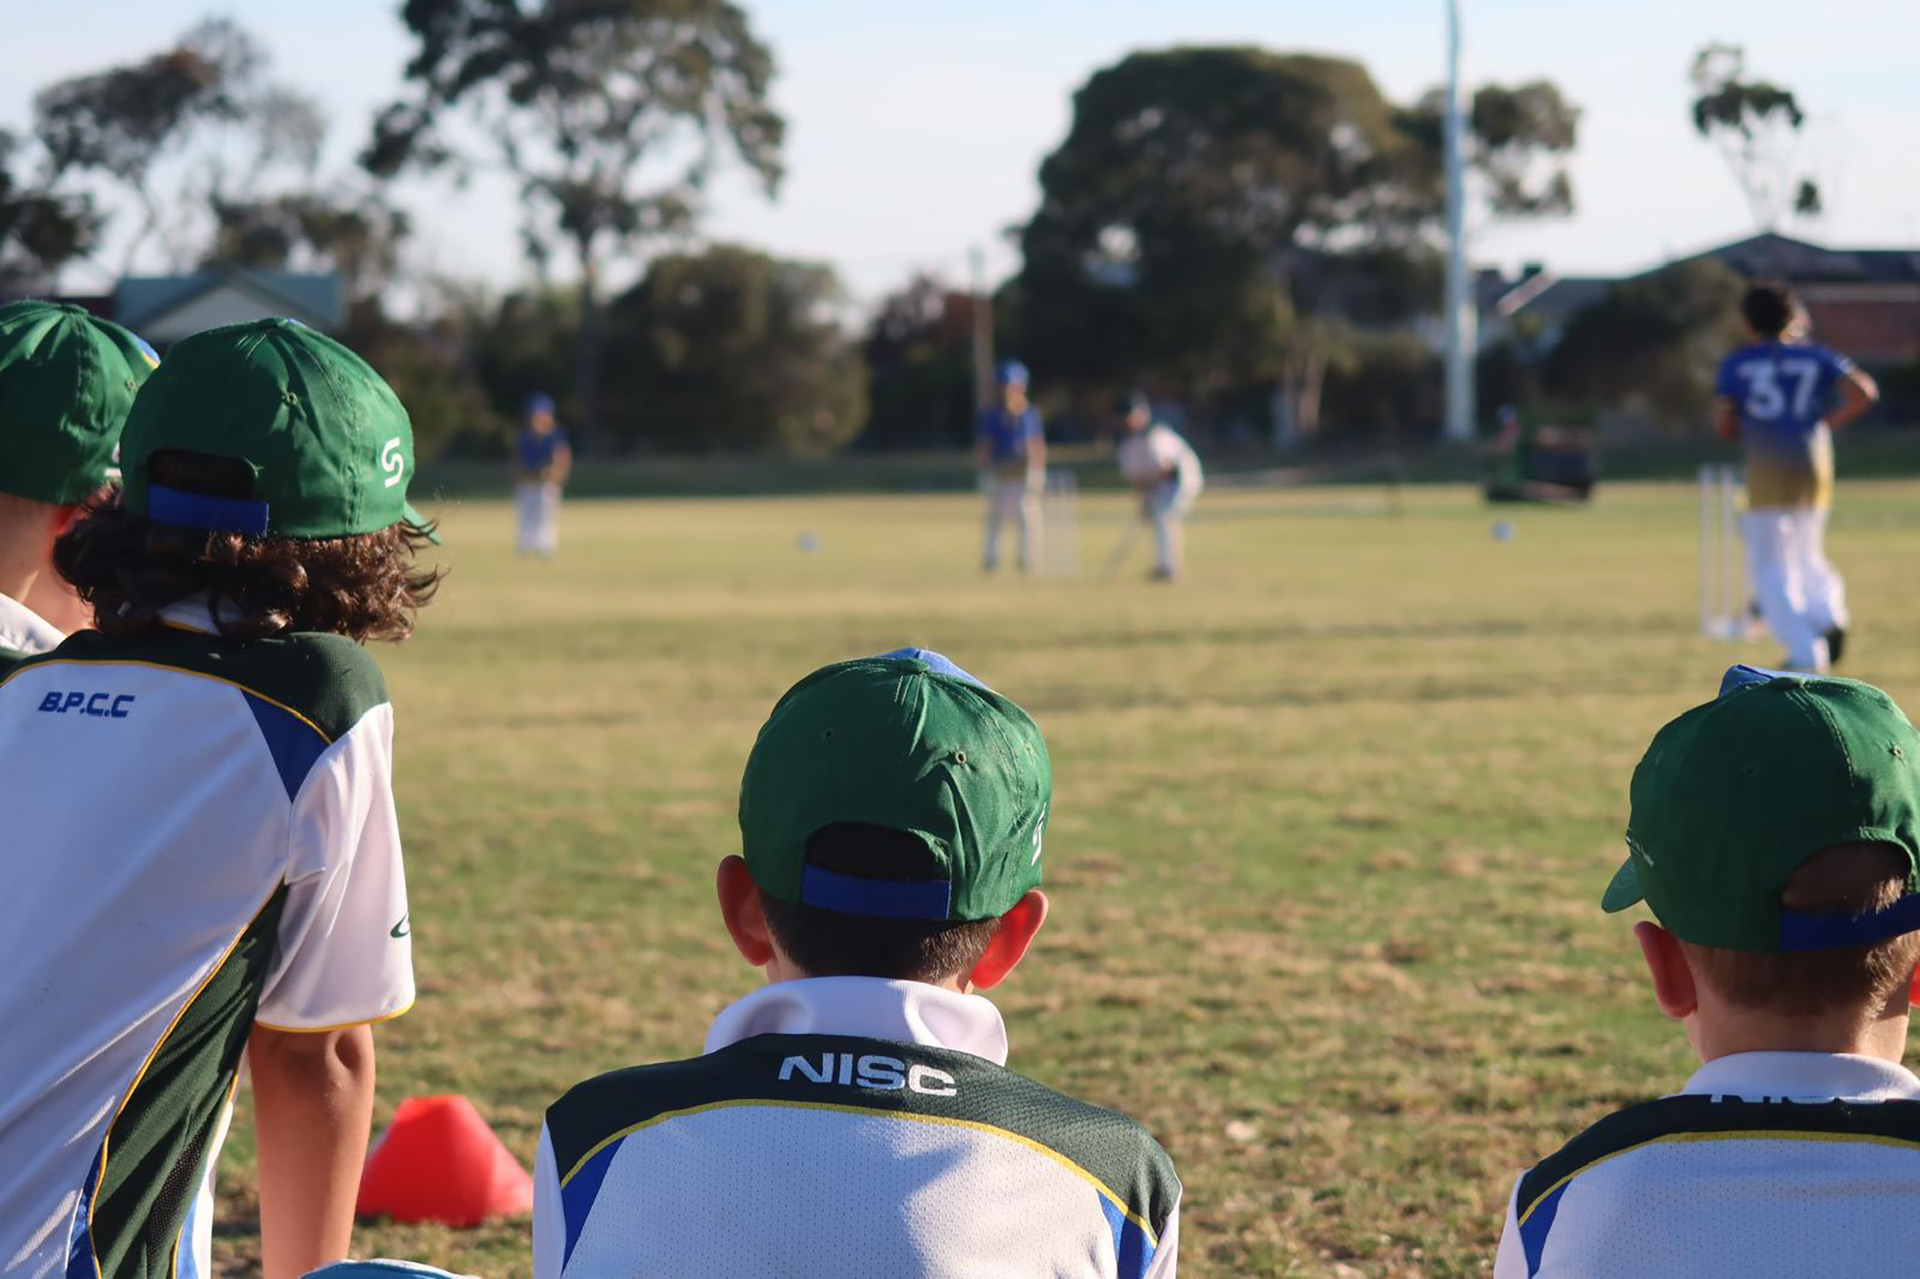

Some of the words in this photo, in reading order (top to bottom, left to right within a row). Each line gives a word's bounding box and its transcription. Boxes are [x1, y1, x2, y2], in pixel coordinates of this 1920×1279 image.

[1737, 357, 1821, 420] 37
[38, 691, 136, 718] B.P.C.C
[778, 1052, 957, 1097] NISC
